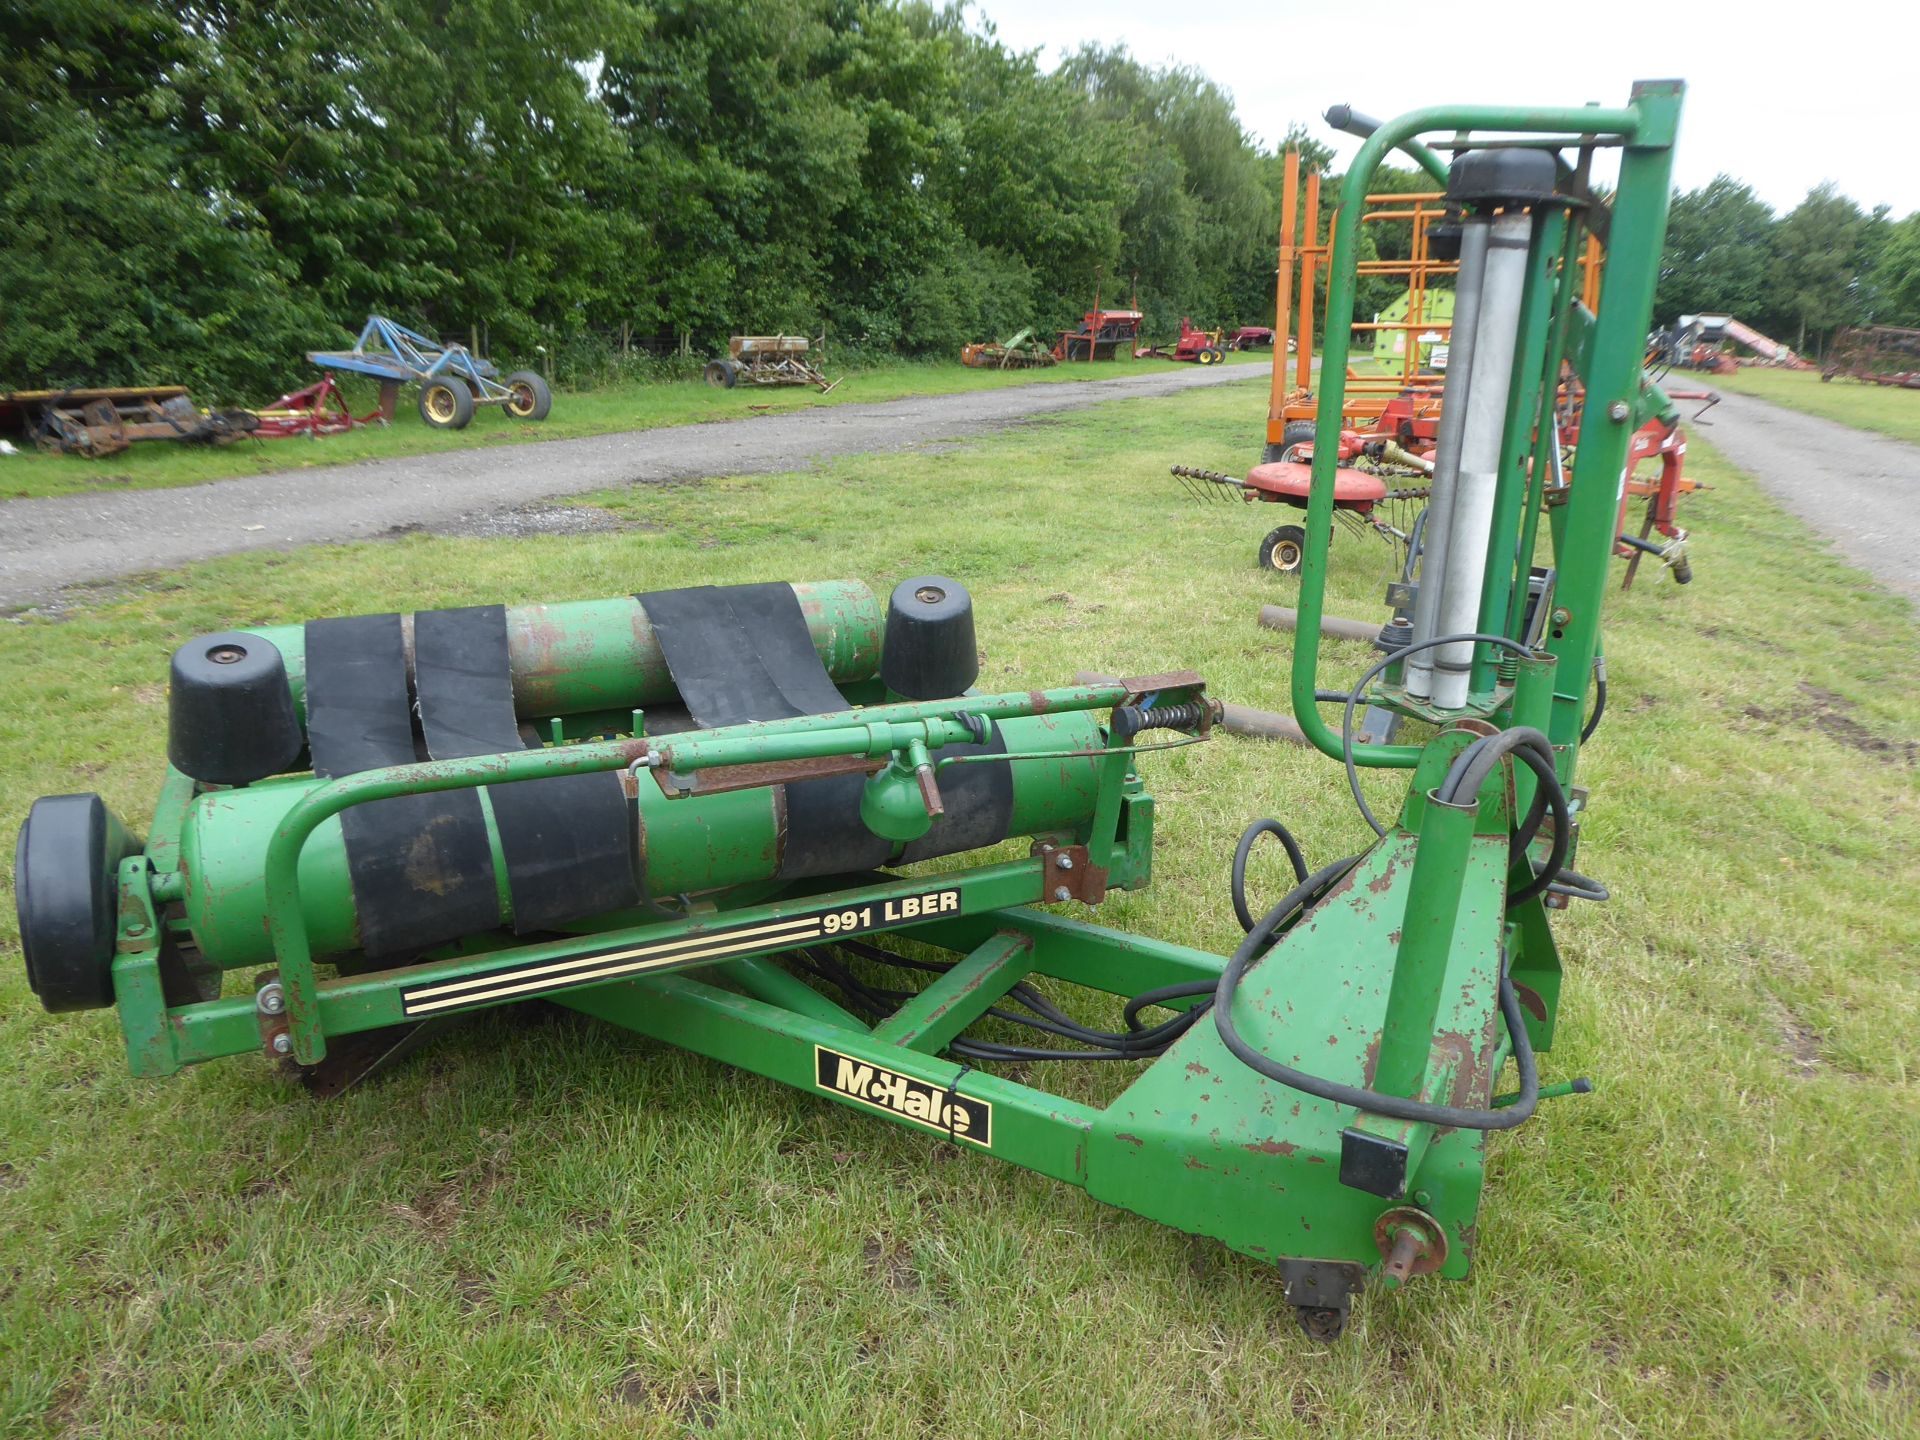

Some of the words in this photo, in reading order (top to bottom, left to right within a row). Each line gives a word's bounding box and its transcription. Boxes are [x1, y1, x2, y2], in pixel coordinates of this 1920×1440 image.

[823, 907, 871, 934] 991
[884, 891, 958, 921] LBER
[836, 1058, 970, 1133] McHale
